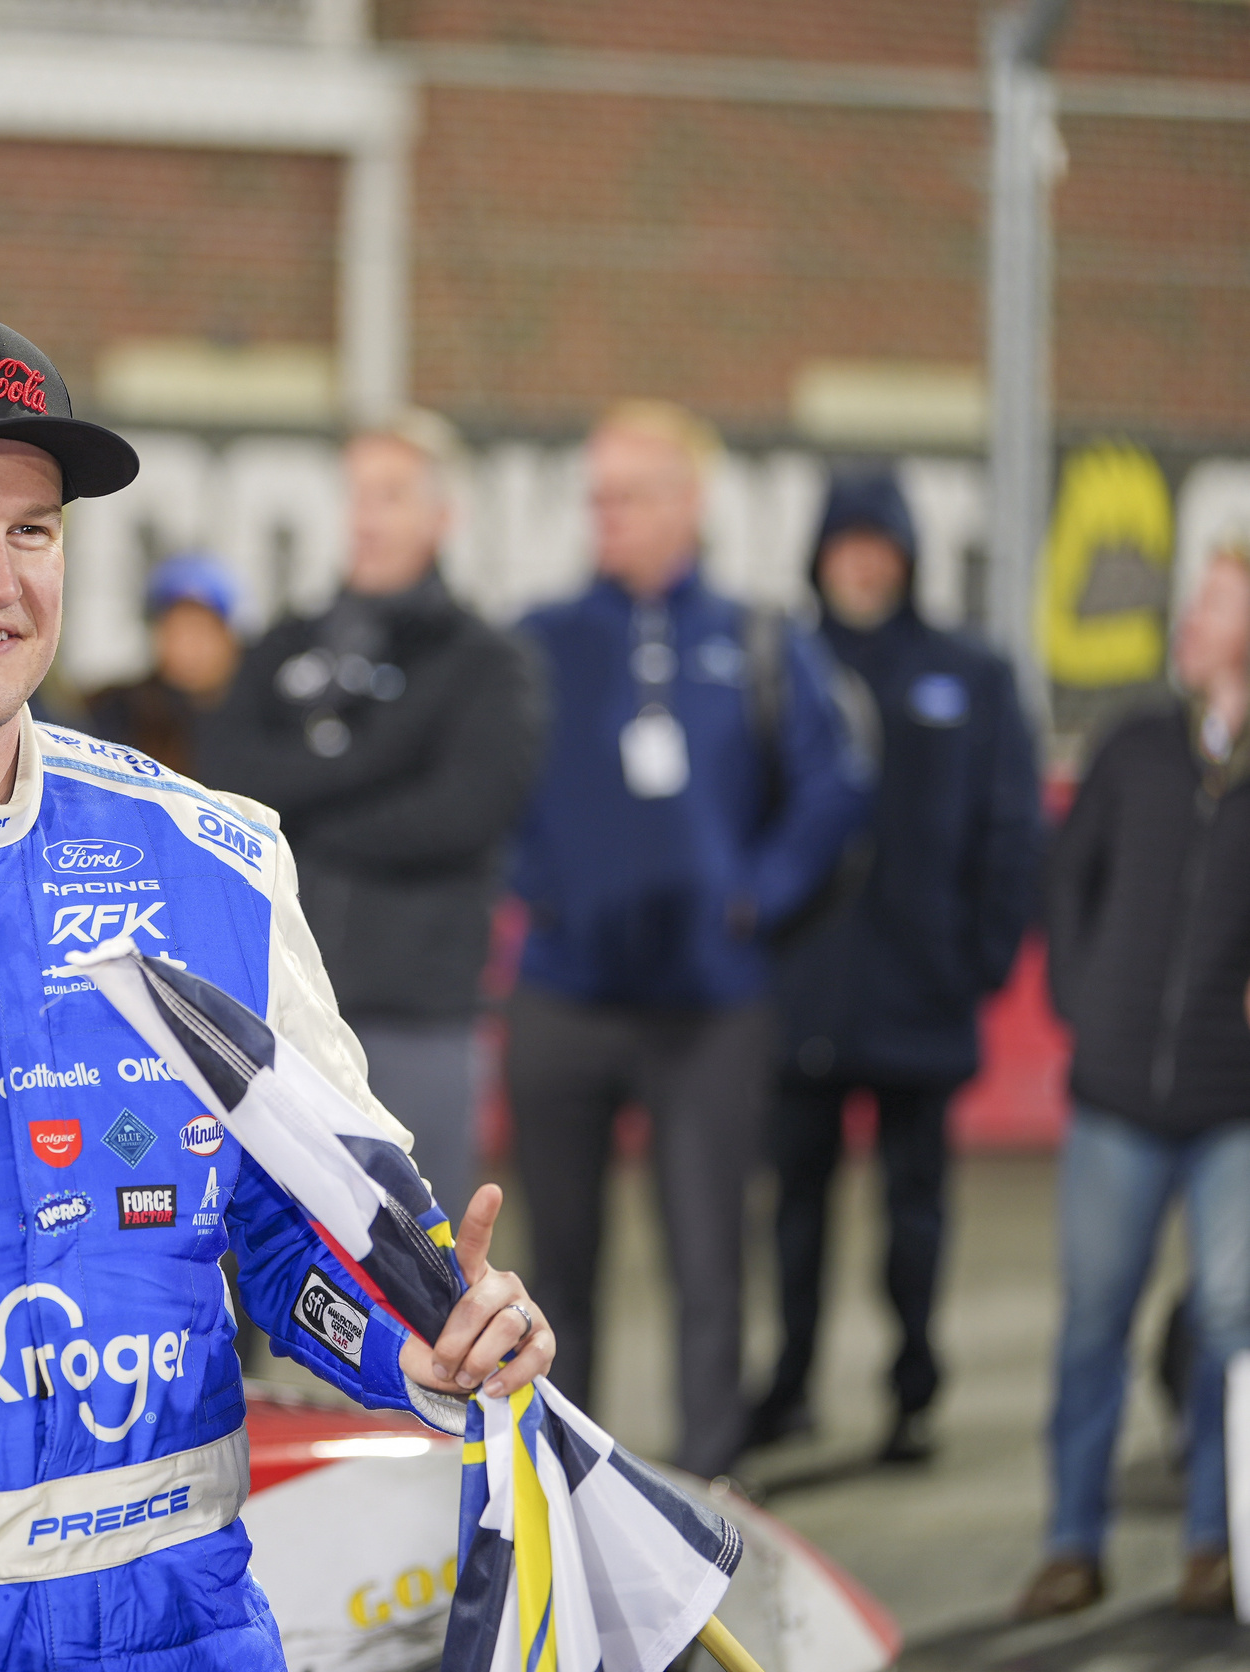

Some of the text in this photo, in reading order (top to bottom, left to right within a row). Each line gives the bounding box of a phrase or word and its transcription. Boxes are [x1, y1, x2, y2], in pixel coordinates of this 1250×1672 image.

[198, 814, 263, 861] OMP
[59, 844, 123, 869] Ford
[43, 880, 161, 896] RACING
[47, 902, 168, 945] RFK
[43, 981, 100, 996] BUILDSU
[0, 1062, 100, 1099] Cottonelle
[118, 1132, 142, 1143] BLUE
[180, 1120, 224, 1149] Minute
[122, 1190, 173, 1213] FORCE
[124, 1210, 173, 1224] FACTOR
[327, 1306, 363, 1339] MANUFACTURER
[331, 1319, 355, 1343] CERTIFIED
[27, 1485, 190, 1546] PREECE
